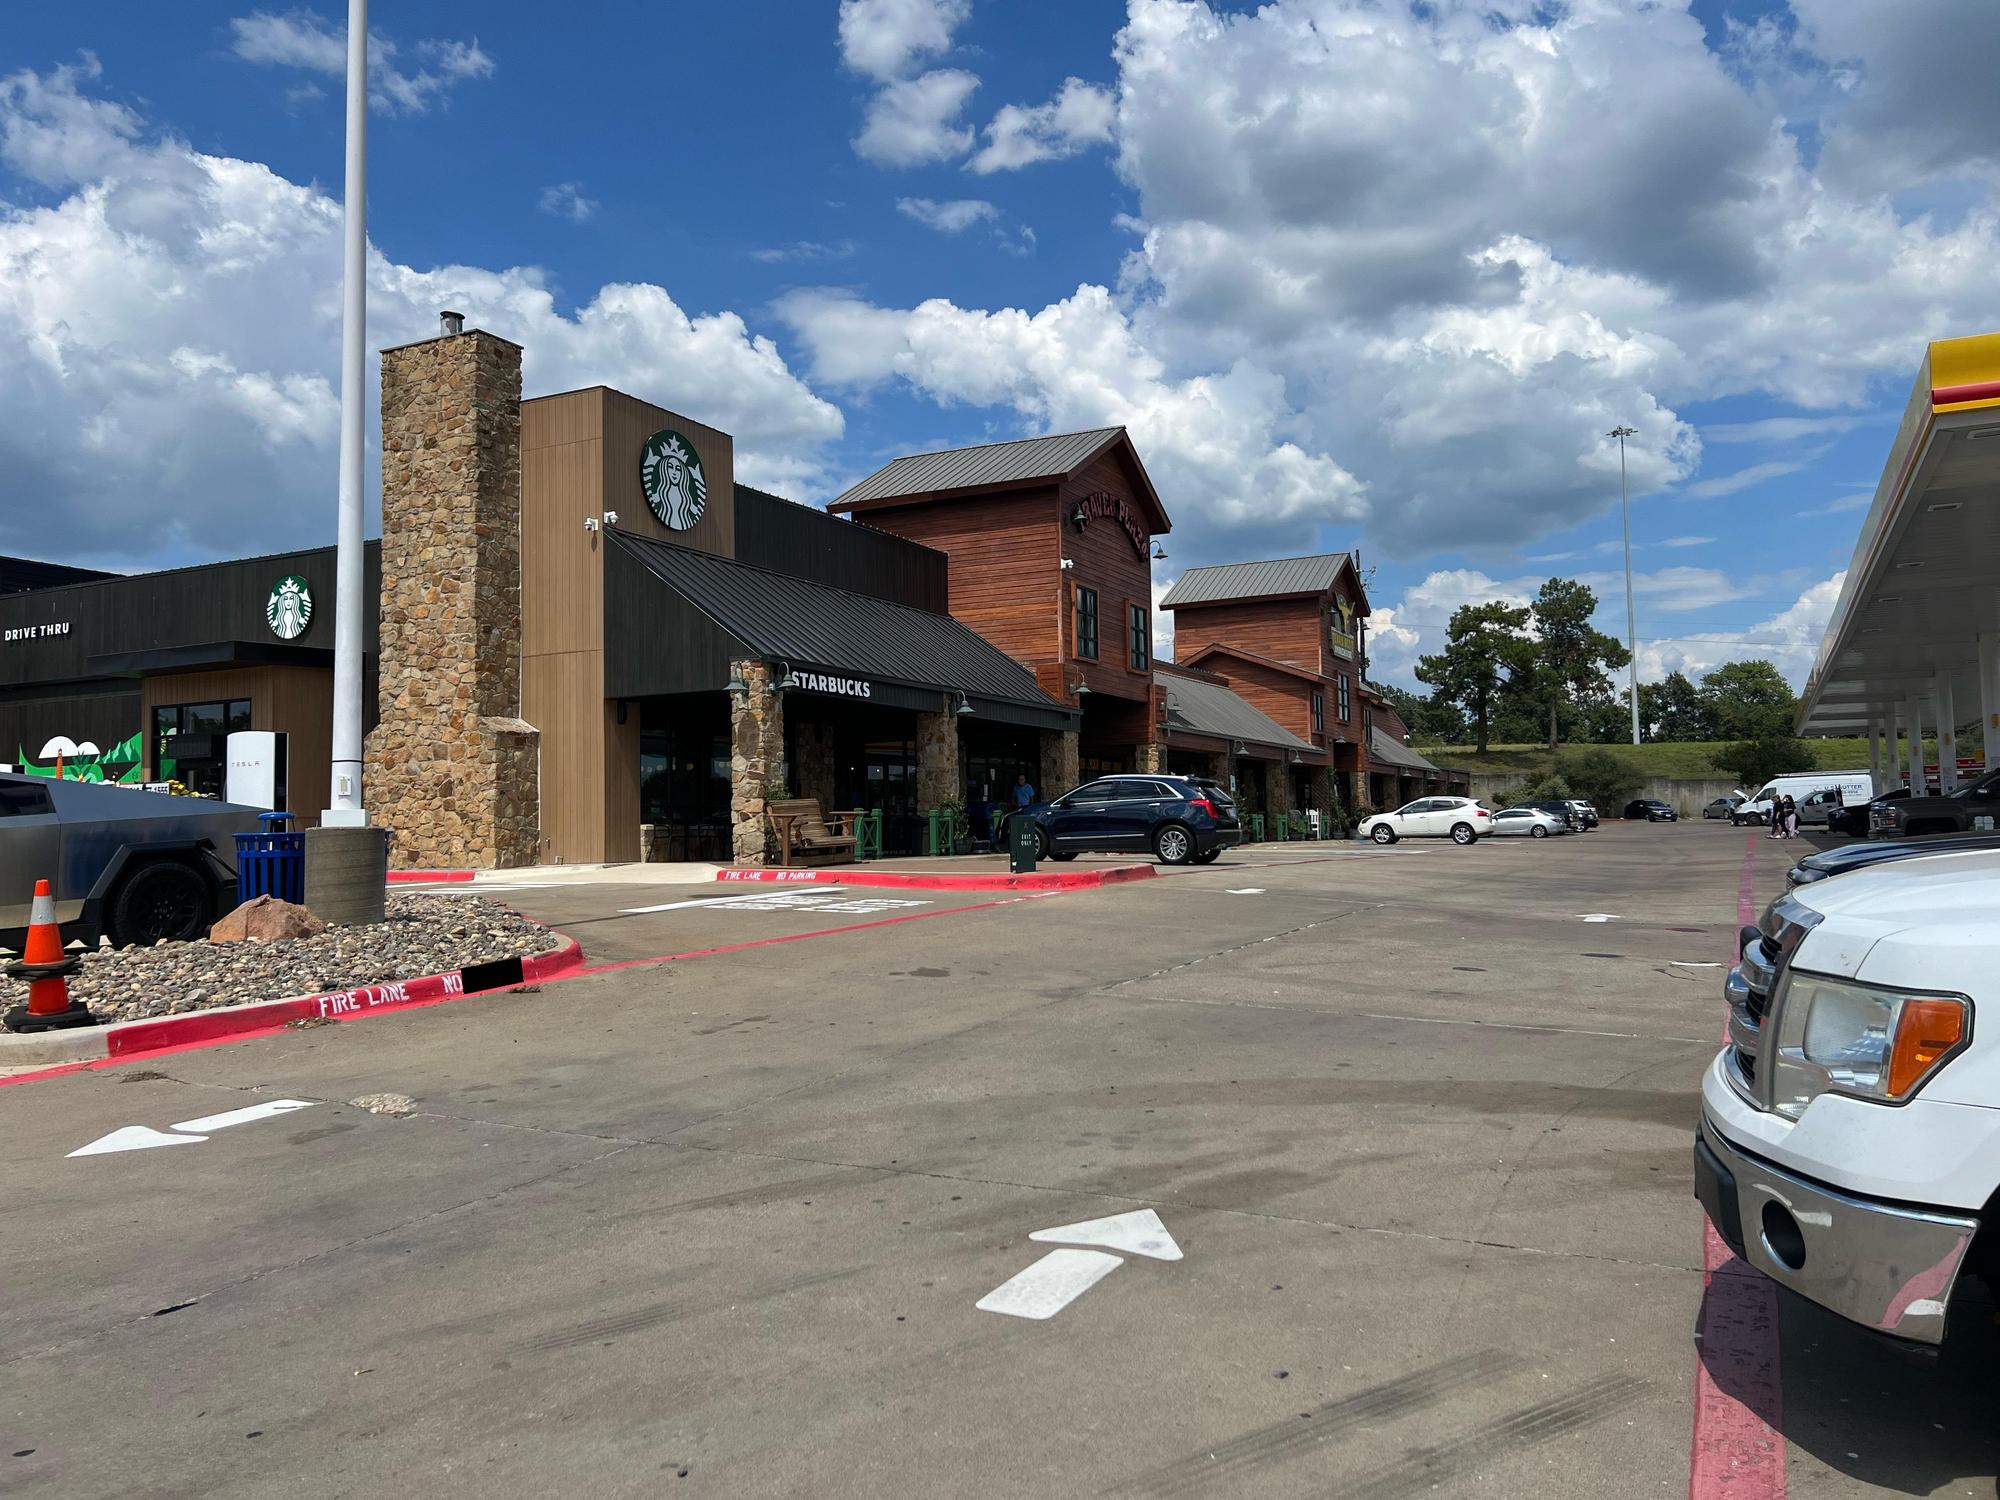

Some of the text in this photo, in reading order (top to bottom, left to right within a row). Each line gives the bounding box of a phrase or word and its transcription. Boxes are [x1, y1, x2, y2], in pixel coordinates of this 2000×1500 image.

[5, 622, 69, 641] DRIVE THRU
[791, 671, 871, 698] STARBUCKS
[724, 871, 816, 880] FIRE LANE NO PARKING
[318, 975, 463, 1017] FIRE LANE NO
